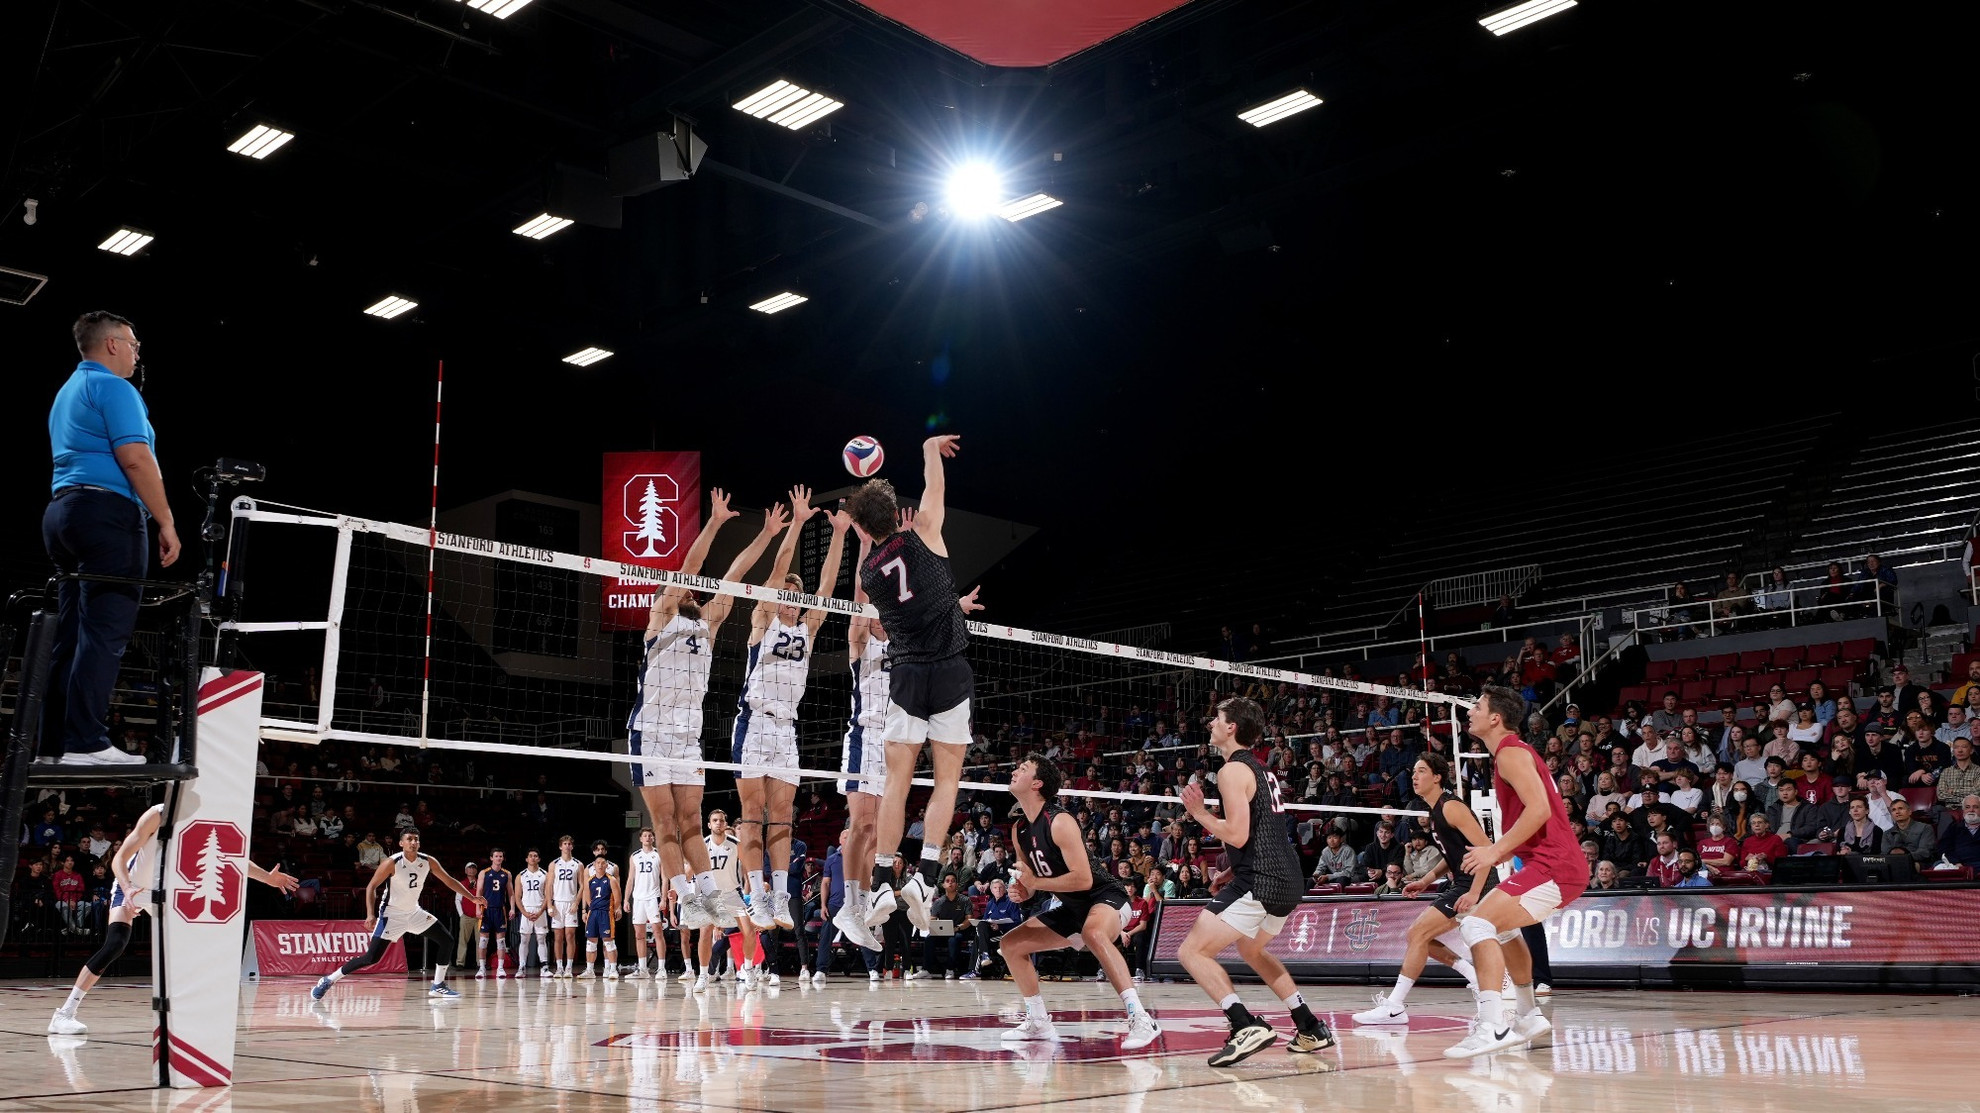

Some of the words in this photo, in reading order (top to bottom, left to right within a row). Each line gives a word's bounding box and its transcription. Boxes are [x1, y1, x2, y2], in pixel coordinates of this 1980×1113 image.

[437, 533, 494, 553] STANFORD
[499, 542, 554, 563] ATHLETICS
[869, 536, 904, 569] STANFORD
[620, 563, 668, 582] STANFORD
[672, 572, 720, 590] ATHLETICS
[881, 556, 914, 602] 7
[777, 590, 818, 607] STANFORD
[822, 597, 864, 614] ATHLETICS
[965, 620, 988, 634] LETICS
[686, 634, 701, 654] 4
[772, 632, 806, 662] 23
[1032, 631, 1064, 646] STANFORD
[1066, 638, 1098, 650] ATHLETICS
[1136, 648, 1164, 660] STANFORD
[1166, 653, 1195, 665] ATHLETICS
[1228, 662, 1254, 674] STANFORD
[1256, 666, 1282, 678] ATHLETICS
[1311, 674, 1334, 686] STANFORD
[1336, 677, 1359, 690] ATHLETICS
[1385, 686, 1406, 696] STANFORD
[1407, 688, 1428, 700] ATHLETICS
[639, 862, 653, 874] 13
[710, 855, 728, 871] 17
[1029, 850, 1052, 877] 16
[409, 872, 418, 888] 2
[559, 869, 573, 881] 22
[492, 880, 500, 891] 3
[526, 880, 540, 891] 12
[595, 887, 602, 898] 1
[1668, 907, 1717, 948] UC
[1726, 905, 1853, 948] IRVINE
